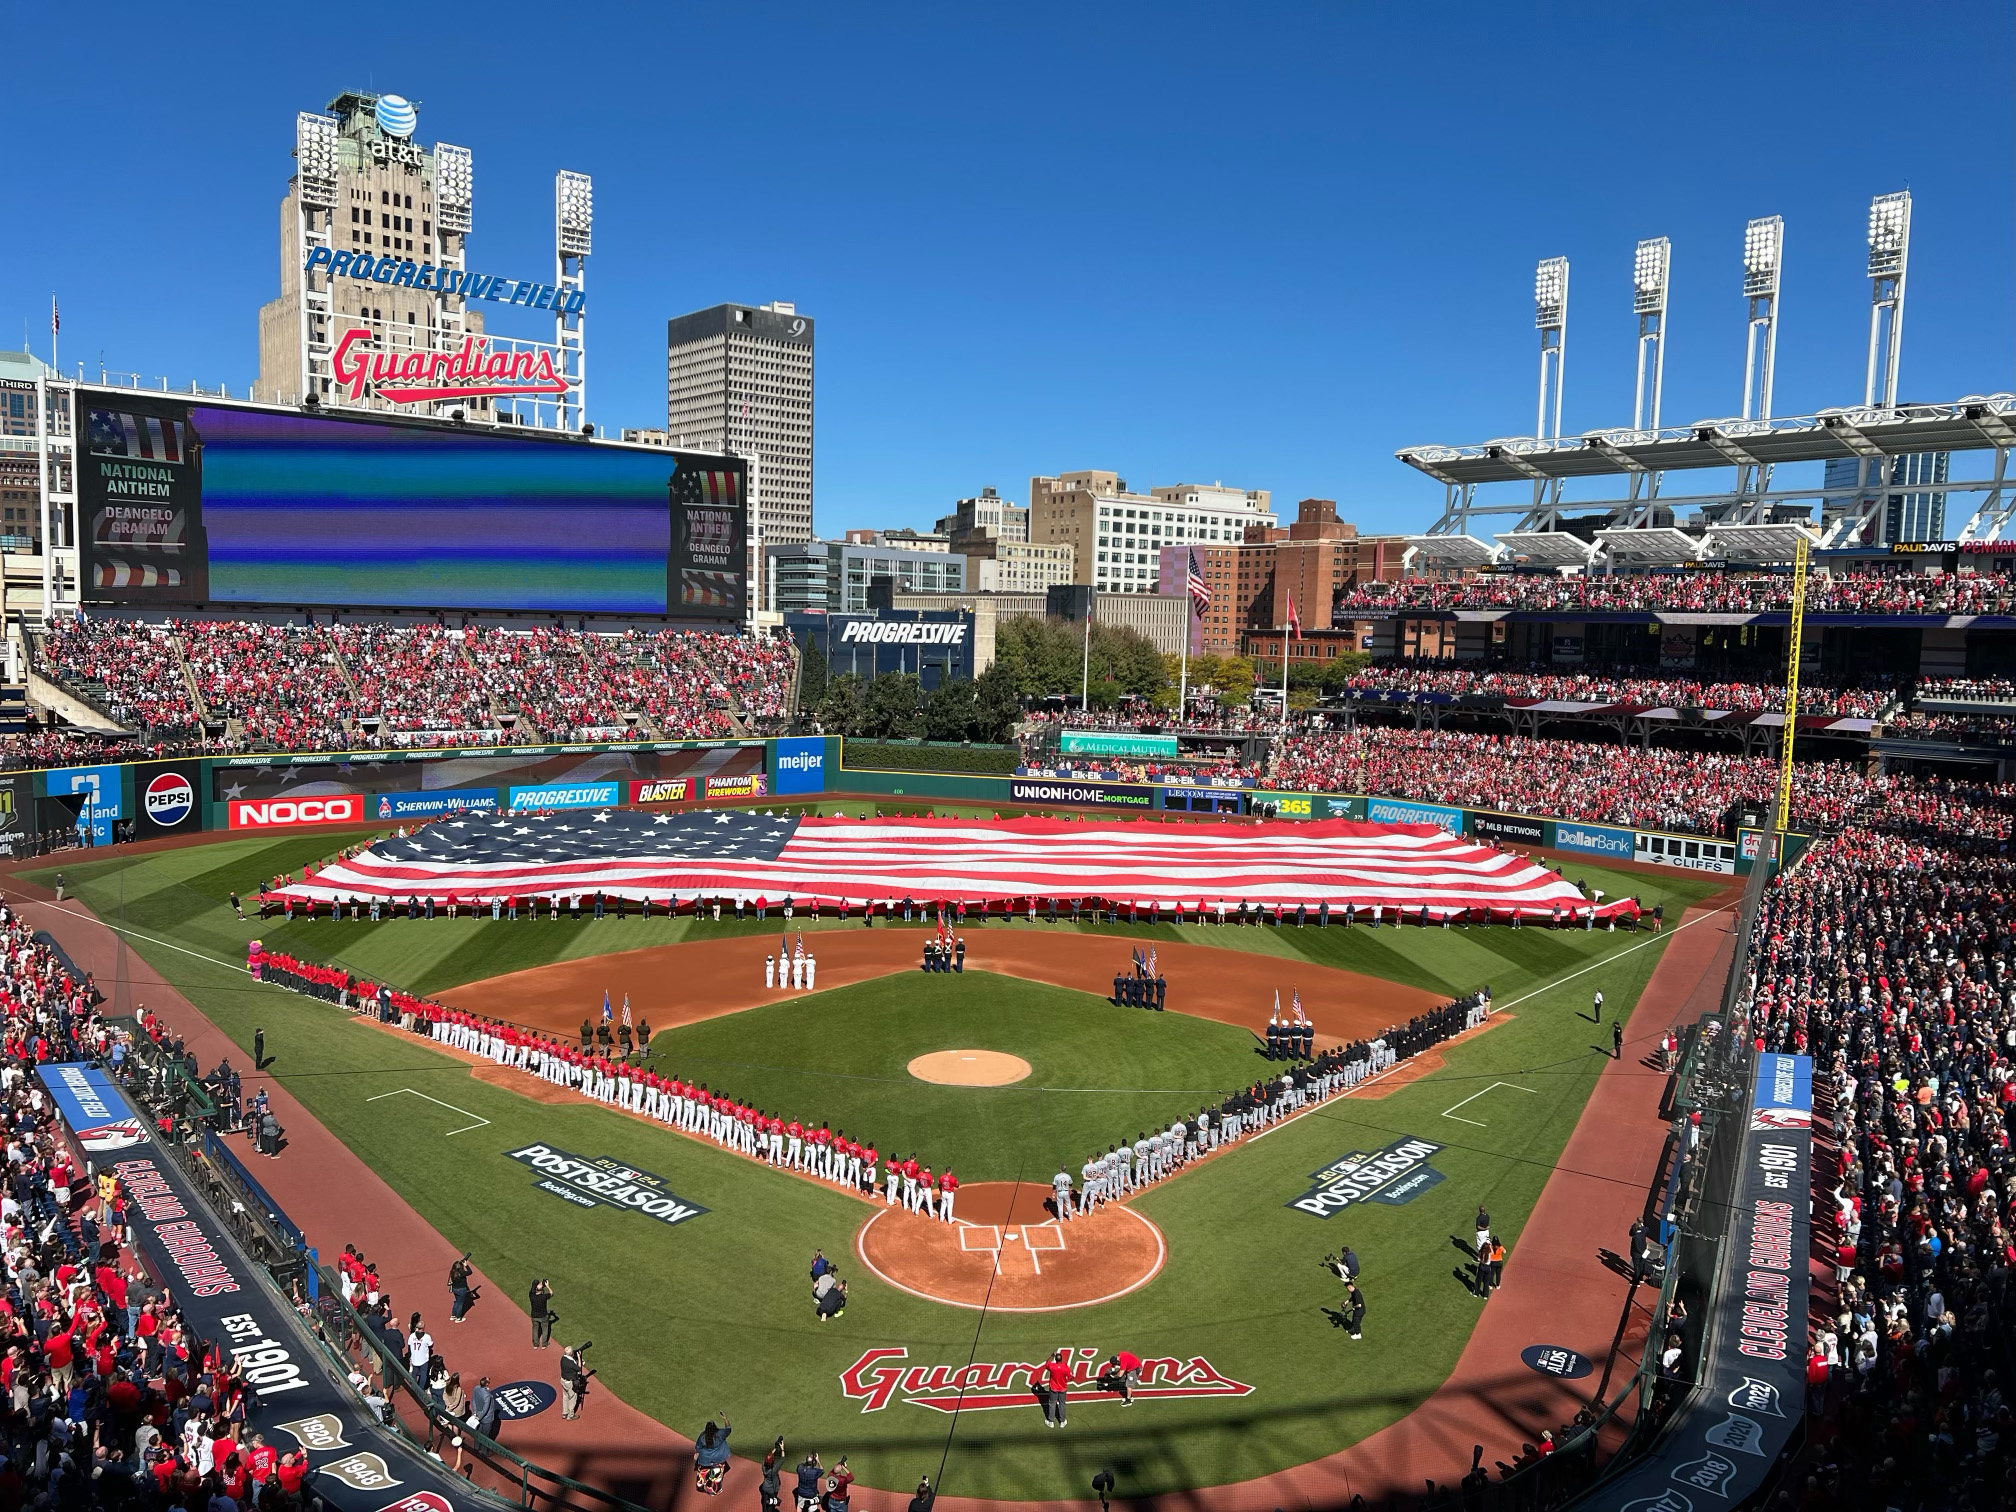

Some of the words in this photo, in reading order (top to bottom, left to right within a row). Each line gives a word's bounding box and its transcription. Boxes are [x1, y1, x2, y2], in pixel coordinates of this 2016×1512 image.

[371, 139, 422, 166] at&t
[304, 246, 507, 301] PROGRESSIVE
[509, 280, 587, 313] FIELD
[793, 319, 806, 337] 9
[331, 328, 570, 405] Guardians
[0, 380, 32, 389] THIRD
[101, 462, 175, 483] NATIONAL
[107, 480, 170, 497] ANTHEM
[105, 506, 173, 521] DEANGELO
[687, 509, 733, 523] NATIONAL
[111, 522, 168, 535] GRAHAM
[690, 522, 729, 535] ANTHEM
[689, 543, 731, 554] DEANGELO
[692, 554, 728, 565] GRAHAM
[841, 621, 967, 644] PROGRESSIVE
[1086, 742, 1128, 752] MEDICAL
[778, 750, 823, 771] meijer
[638, 783, 687, 801] BLASTER
[707, 786, 751, 797] FIREWORKS
[708, 777, 752, 787] PHANTOM
[149, 791, 190, 807] PEPSI
[513, 787, 613, 807] PROGRESSIVE
[1103, 794, 1149, 804] MORTGAGE
[239, 800, 352, 825] NOCO
[1370, 804, 1456, 828] PROGRESSIVE
[1486, 822, 1502, 833] MLB
[1503, 824, 1541, 837] NETWORK
[1673, 857, 1722, 872] CLIFFS
[1758, 1143, 1798, 1172] 1901
[511, 1145, 699, 1223] POSTSEASON
[595, 1159, 617, 1169] 20
[637, 1175, 661, 1186] 24
[1294, 1140, 1439, 1216] POSTSEASON
[1764, 1172, 1789, 1189] EST.
[539, 1180, 596, 1208] Booking.com
[1385, 1174, 1430, 1199] Booking.com
[113, 1159, 188, 1222] CLEVELAND
[153, 1220, 241, 1297] GUARDIANS
[1748, 1200, 1794, 1270] GUARDIANS
[1738, 1270, 1792, 1361] CLEVELAND
[220, 1313, 264, 1343] EST.
[413, 1342, 422, 1351] 17
[229, 1338, 310, 1396] 1901
[1546, 1350, 1568, 1374] ALDS
[839, 1347, 1257, 1414] Guardins
[500, 1387, 535, 1414] ALDS
[1745, 1382, 1771, 1411] 2022
[300, 1419, 336, 1447] 1920
[1726, 1420, 1754, 1448] 2020
[339, 1457, 385, 1487] 1948
[1690, 1460, 1729, 1488] 2018
